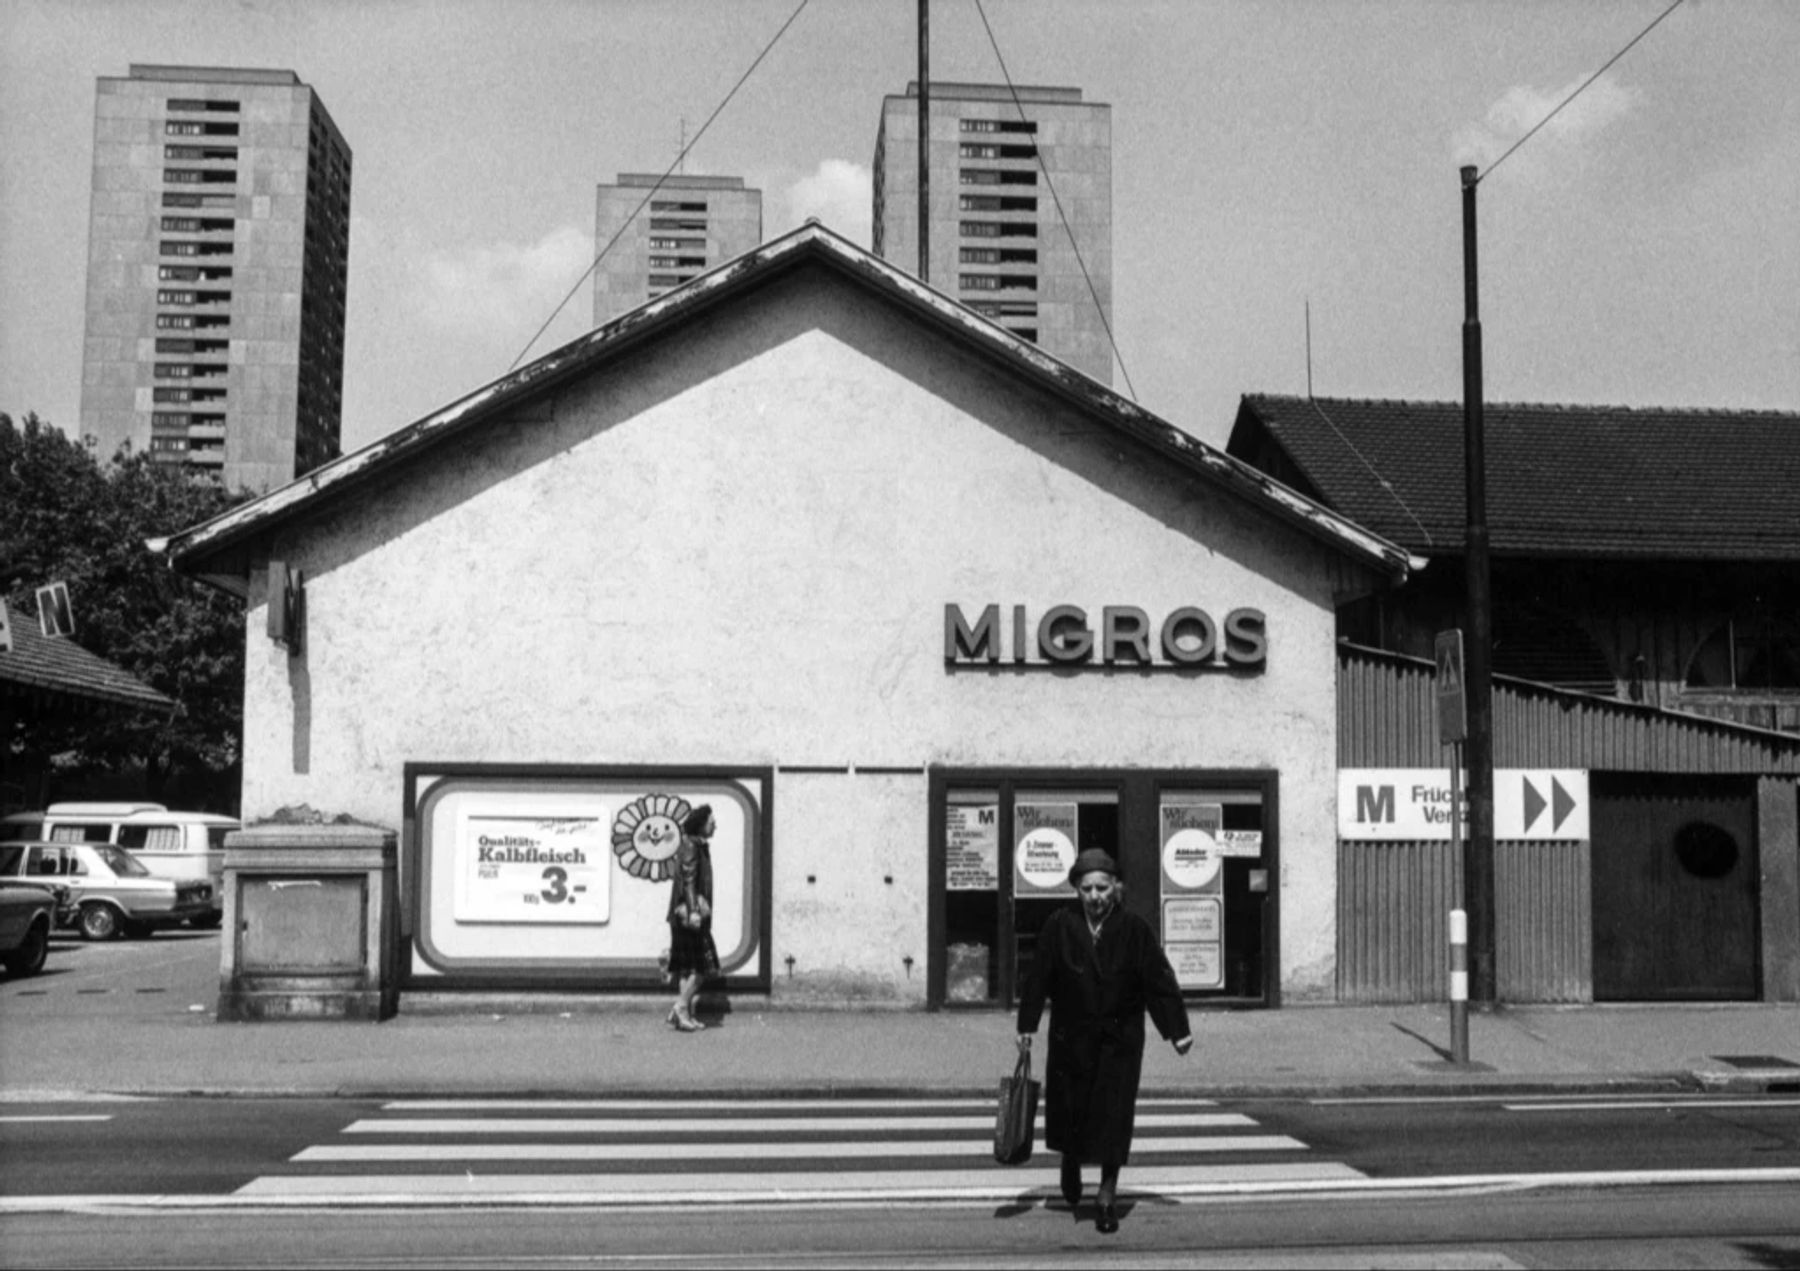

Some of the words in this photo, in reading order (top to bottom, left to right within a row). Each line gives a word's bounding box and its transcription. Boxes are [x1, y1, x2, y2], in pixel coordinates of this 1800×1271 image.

[944, 603, 1268, 670] MIGROS
[978, 810, 995, 824] M
[1356, 785, 1395, 823] M
[478, 835, 541, 847] Qualitäts-
[478, 847, 587, 864] Kalbfleisch
[541, 866, 587, 905] 3.-
